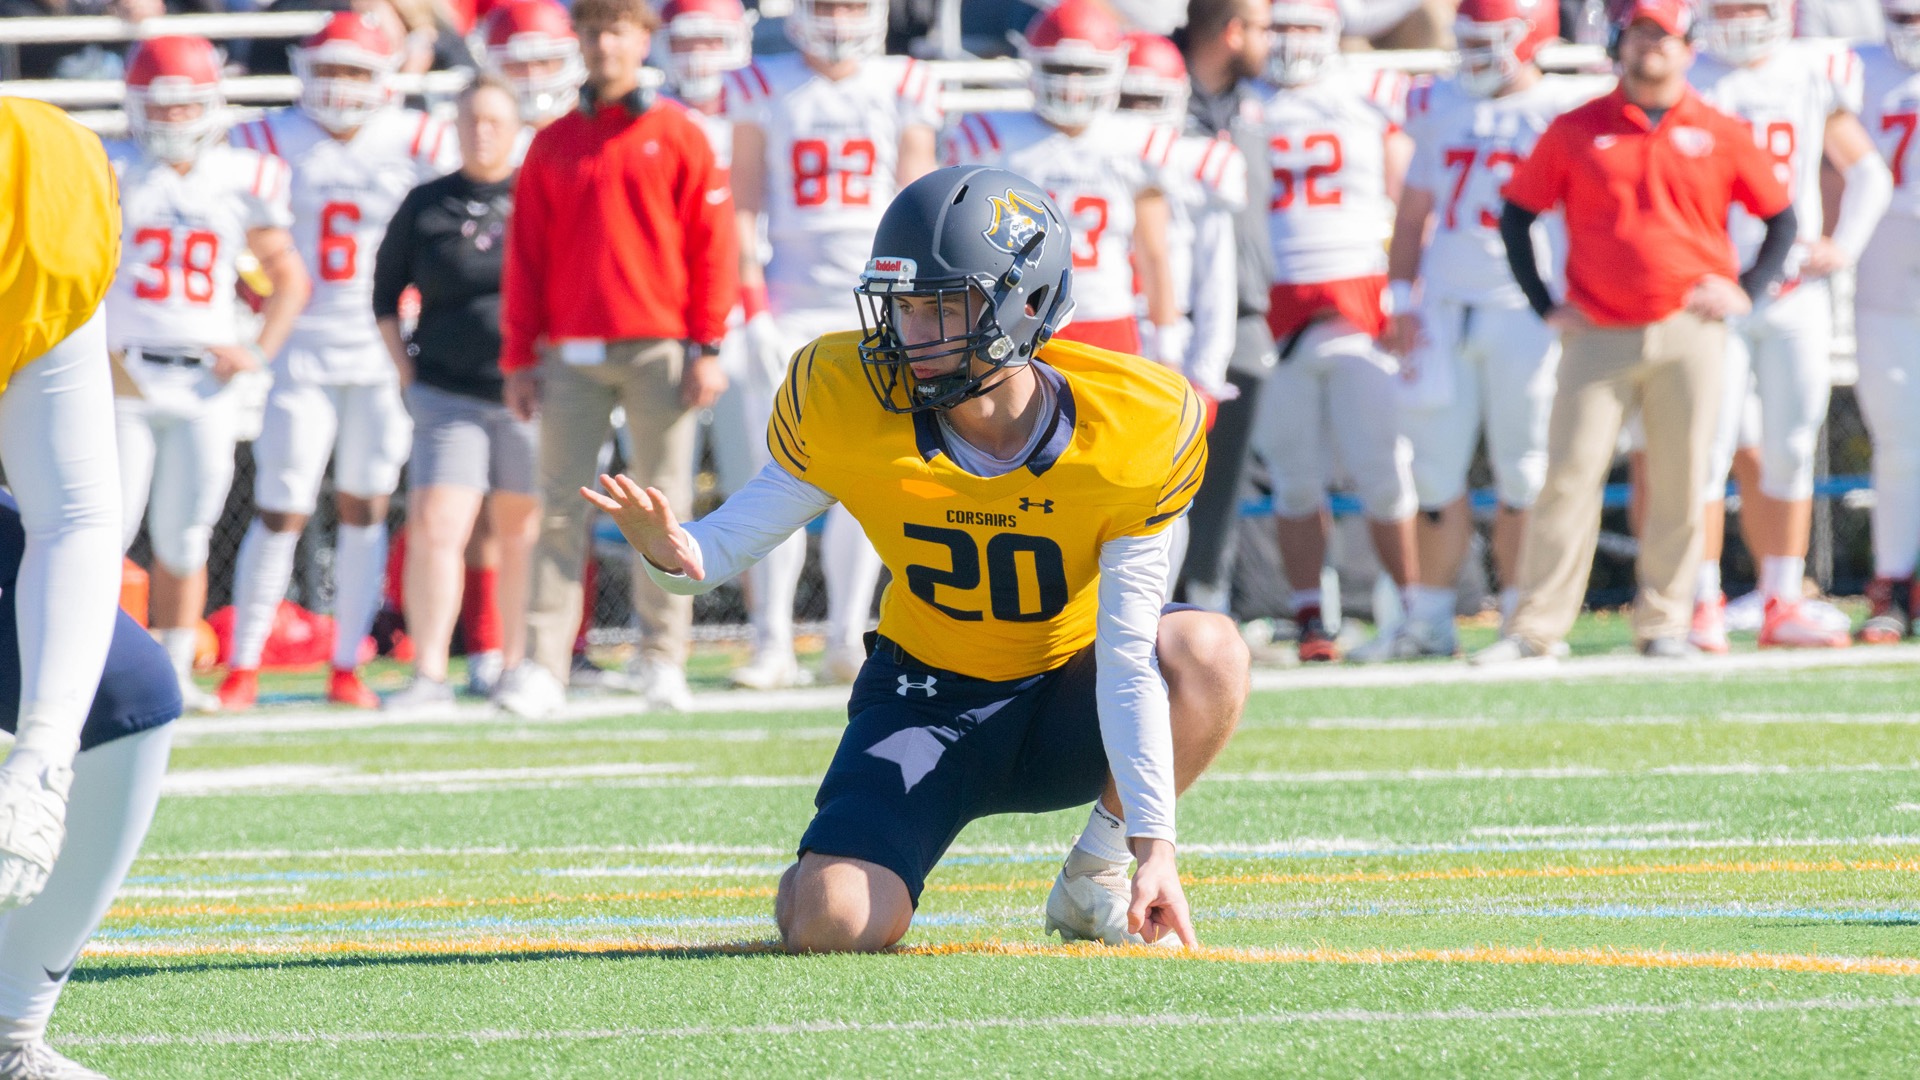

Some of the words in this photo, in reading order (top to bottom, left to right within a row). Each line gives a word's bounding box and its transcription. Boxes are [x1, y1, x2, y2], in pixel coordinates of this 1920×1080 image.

[791, 138, 876, 206] 82
[134, 226, 220, 304] 38
[319, 200, 362, 283] 6
[946, 509, 1017, 528] CORSAIRS
[903, 522, 1069, 623] 20
